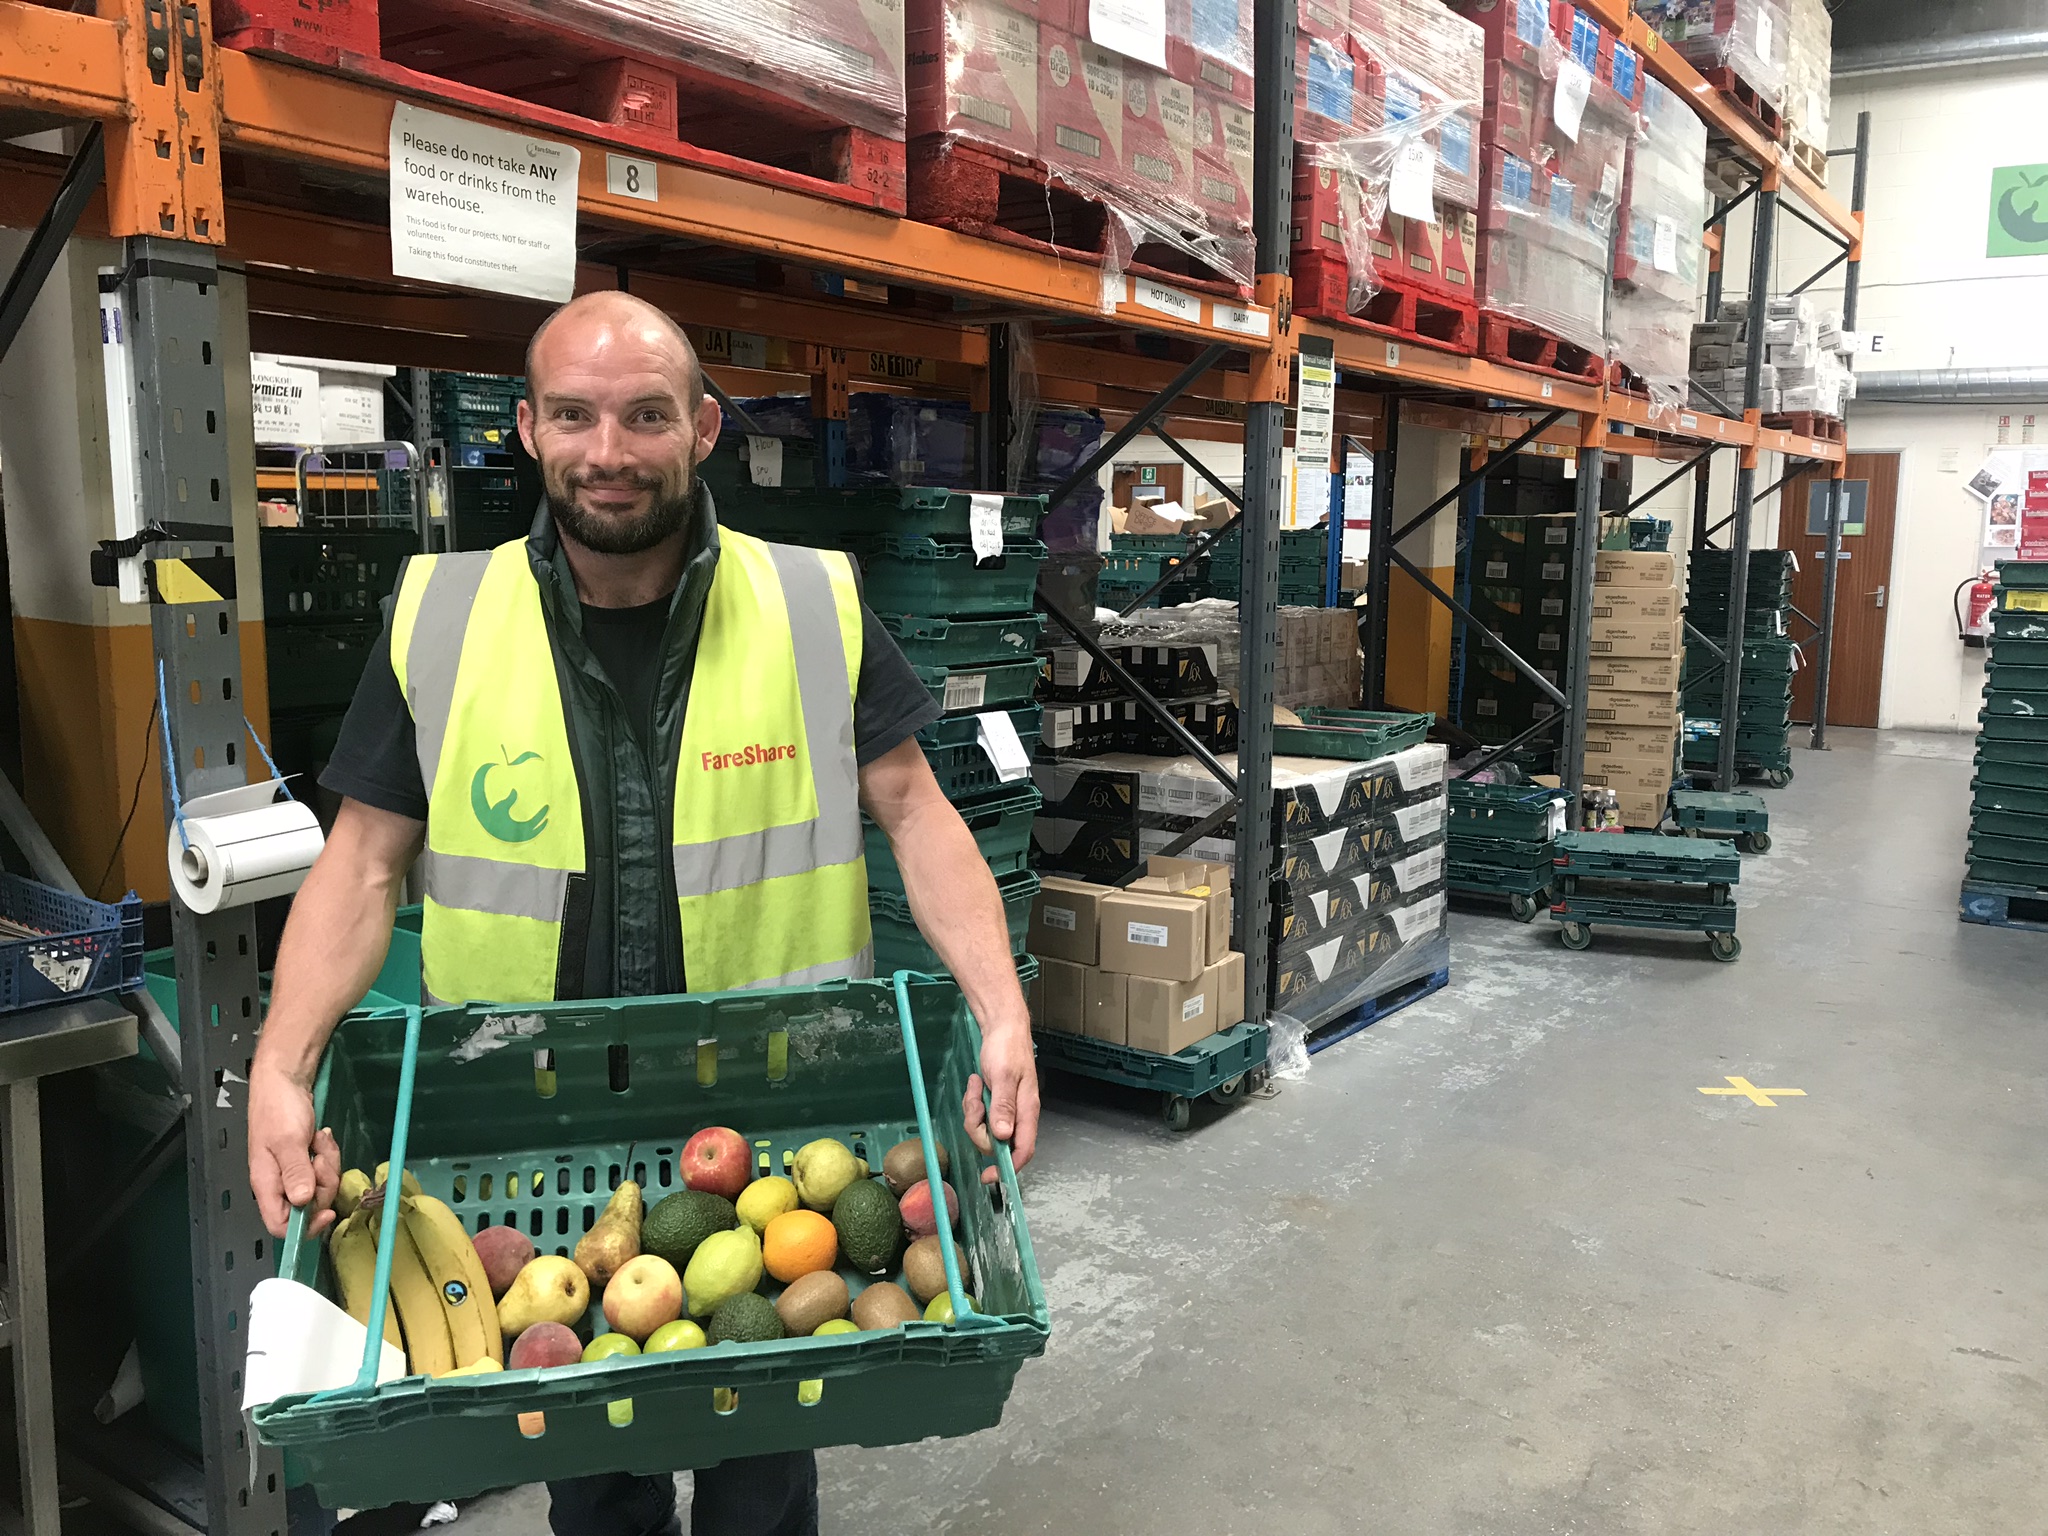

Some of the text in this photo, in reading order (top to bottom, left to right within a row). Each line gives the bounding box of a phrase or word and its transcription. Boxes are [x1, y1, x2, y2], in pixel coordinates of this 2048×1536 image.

[1050, 57, 1069, 75] Bran
[403, 132, 558, 181] Please do not take ANY
[534, 145, 561, 157] FareShare
[404, 157, 557, 205] food or drinks from the
[626, 164, 640, 193] 8
[405, 187, 485, 214] warehouse.
[406, 215, 551, 250] This food is for our projects, NOT for staff or
[407, 229, 447, 243] volunteers.
[408, 246, 519, 273] Taking this food constitutes theft.
[1150, 288, 1187, 309] HOT DRINKS
[1233, 312, 1250, 324] DAIRY
[1389, 346, 1395, 360] 6
[1871, 335, 1884, 352] E
[701, 743, 797, 771] FareShare
